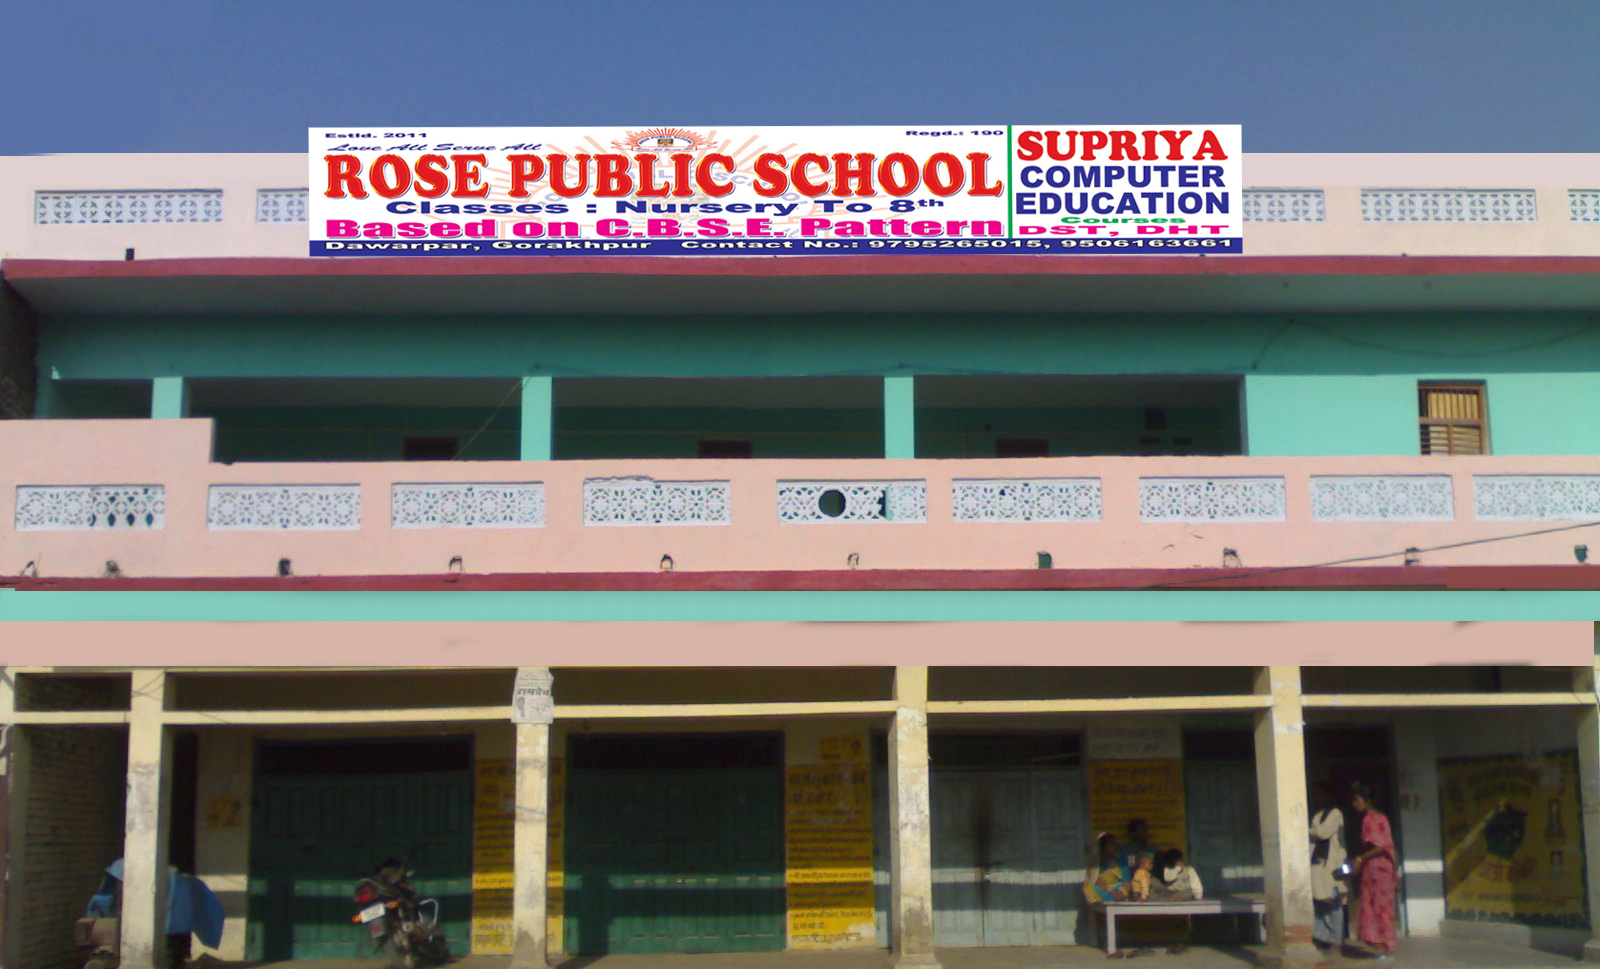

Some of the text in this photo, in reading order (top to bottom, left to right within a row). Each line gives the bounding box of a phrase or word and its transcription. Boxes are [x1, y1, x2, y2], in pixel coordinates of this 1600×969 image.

[327, 143, 543, 152] Love All Serve All
[1017, 129, 1229, 162] SUPRIYA
[323, 153, 491, 199] ROSE
[506, 153, 736, 198] PUBLIC
[752, 152, 1004, 197] SCHOOL
[1020, 165, 1226, 189] COMPUTER
[386, 201, 569, 214] Classes
[616, 200, 799, 217] Nursery
[813, 199, 873, 213] To
[889, 198, 944, 213] 8th
[1015, 191, 1229, 215] EDUCATION
[326, 218, 1005, 239] Based on C.B.S.E. Pattern
[1060, 216, 1187, 224] Courses
[1018, 224, 1229, 237] DST, DHT
[325, 238, 1232, 251] Dawarpar, Gorakhpur Contact No.: 9795265015, 9506163661
